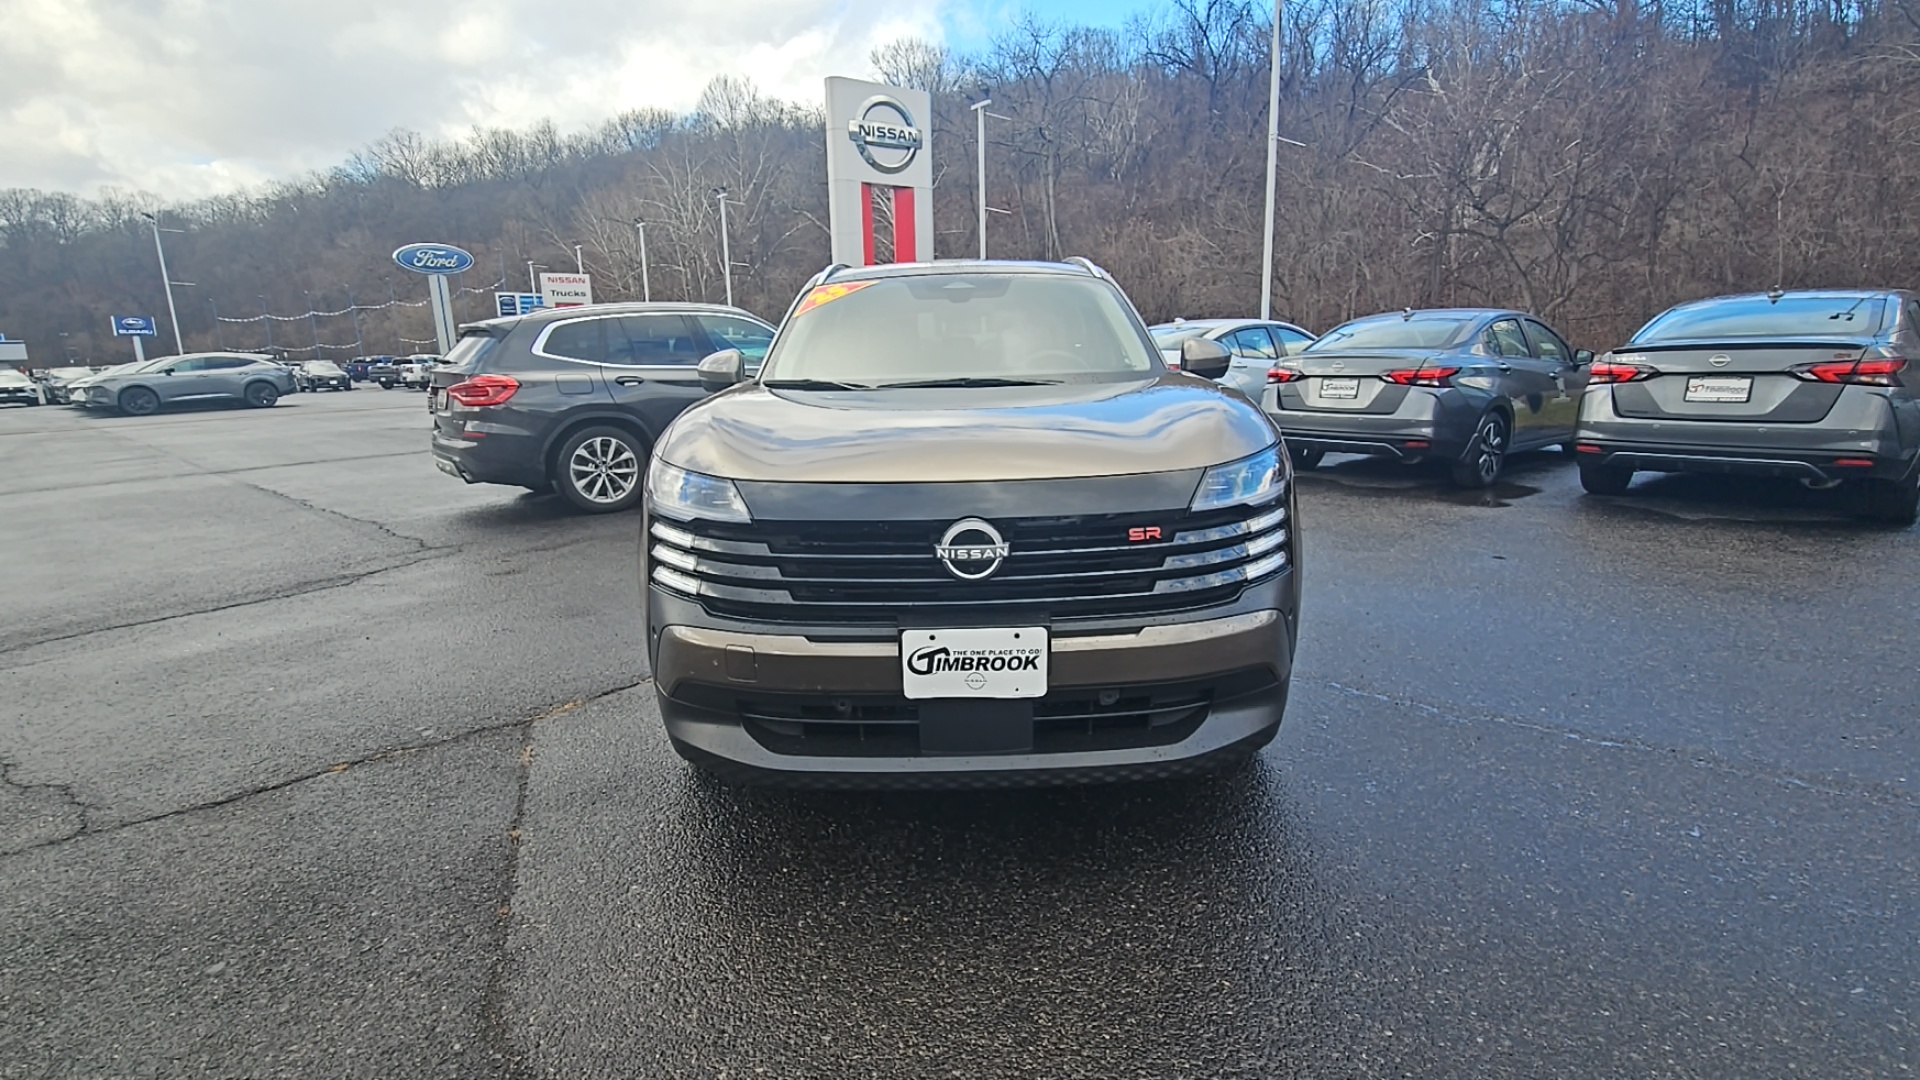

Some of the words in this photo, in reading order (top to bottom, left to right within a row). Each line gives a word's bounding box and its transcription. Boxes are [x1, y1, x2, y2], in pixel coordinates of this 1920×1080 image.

[858, 124, 918, 143] NISSAN
[413, 249, 458, 267] Ford
[547, 276, 586, 284] NISSAN
[549, 289, 587, 297] Trucks
[1129, 526, 1162, 541] SR
[936, 547, 1010, 560] NISSAN
[907, 646, 1041, 675] TIMBROOK
